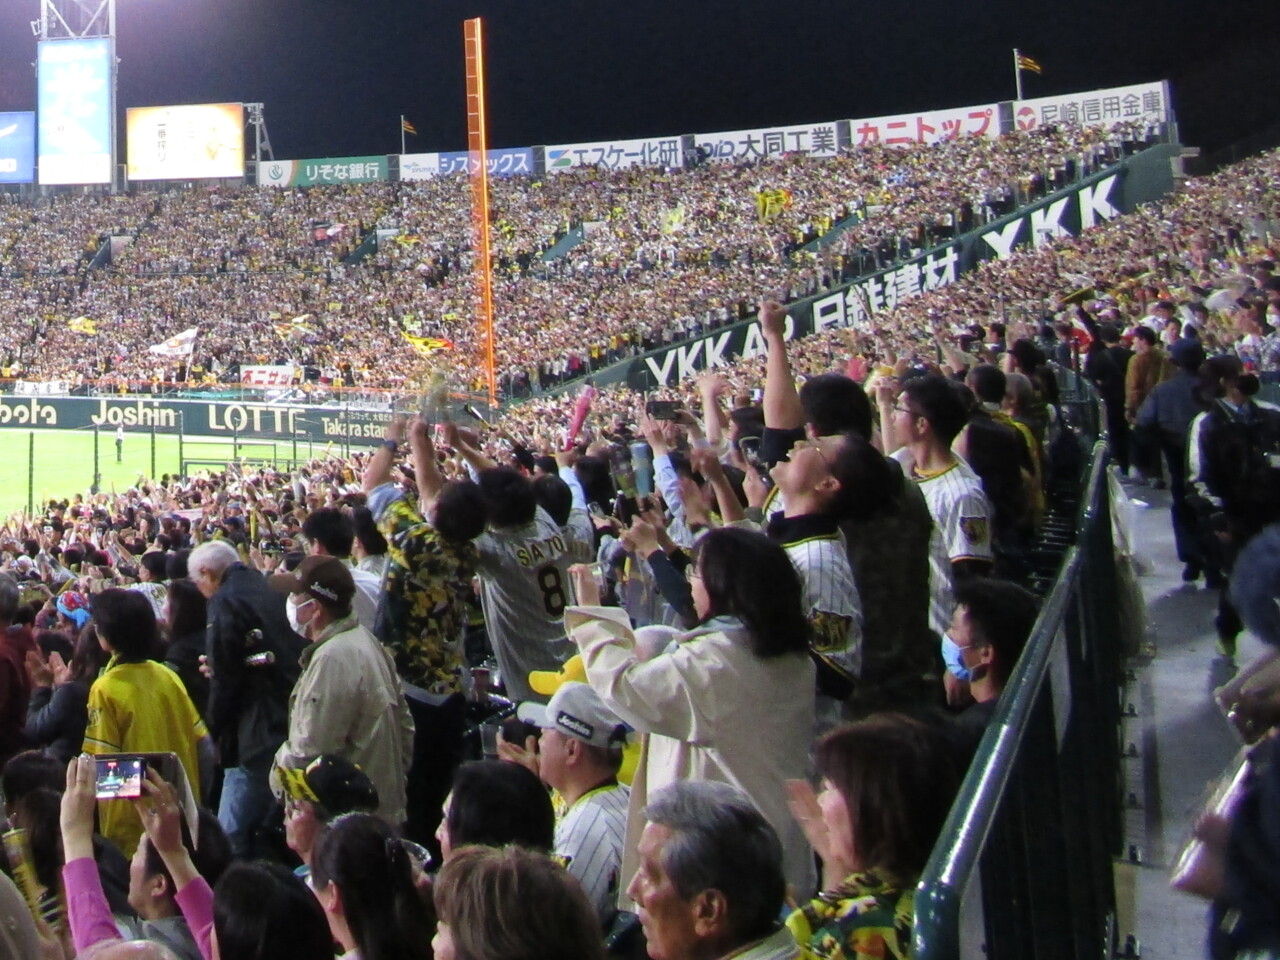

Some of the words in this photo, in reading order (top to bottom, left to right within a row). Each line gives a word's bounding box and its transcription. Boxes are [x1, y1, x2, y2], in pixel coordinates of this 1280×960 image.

[1040, 89, 1162, 125] 尼崎信用金庫
[738, 126, 837, 159] 大同工業
[857, 108, 993, 147] カニトップ
[440, 153, 530, 175] シスメックス
[572, 139, 679, 168] エスケー化研
[306, 161, 380, 182] りそな銀行
[981, 174, 1122, 260] YKK
[645, 331, 732, 386] YKK
[242, 369, 292, 385] 不二サッ
[91, 400, 177, 427] Joshin
[208, 404, 307, 436] LOTTE
[321, 417, 362, 436] Takara
[516, 535, 563, 568] SATO
[538, 565, 568, 618] 8
